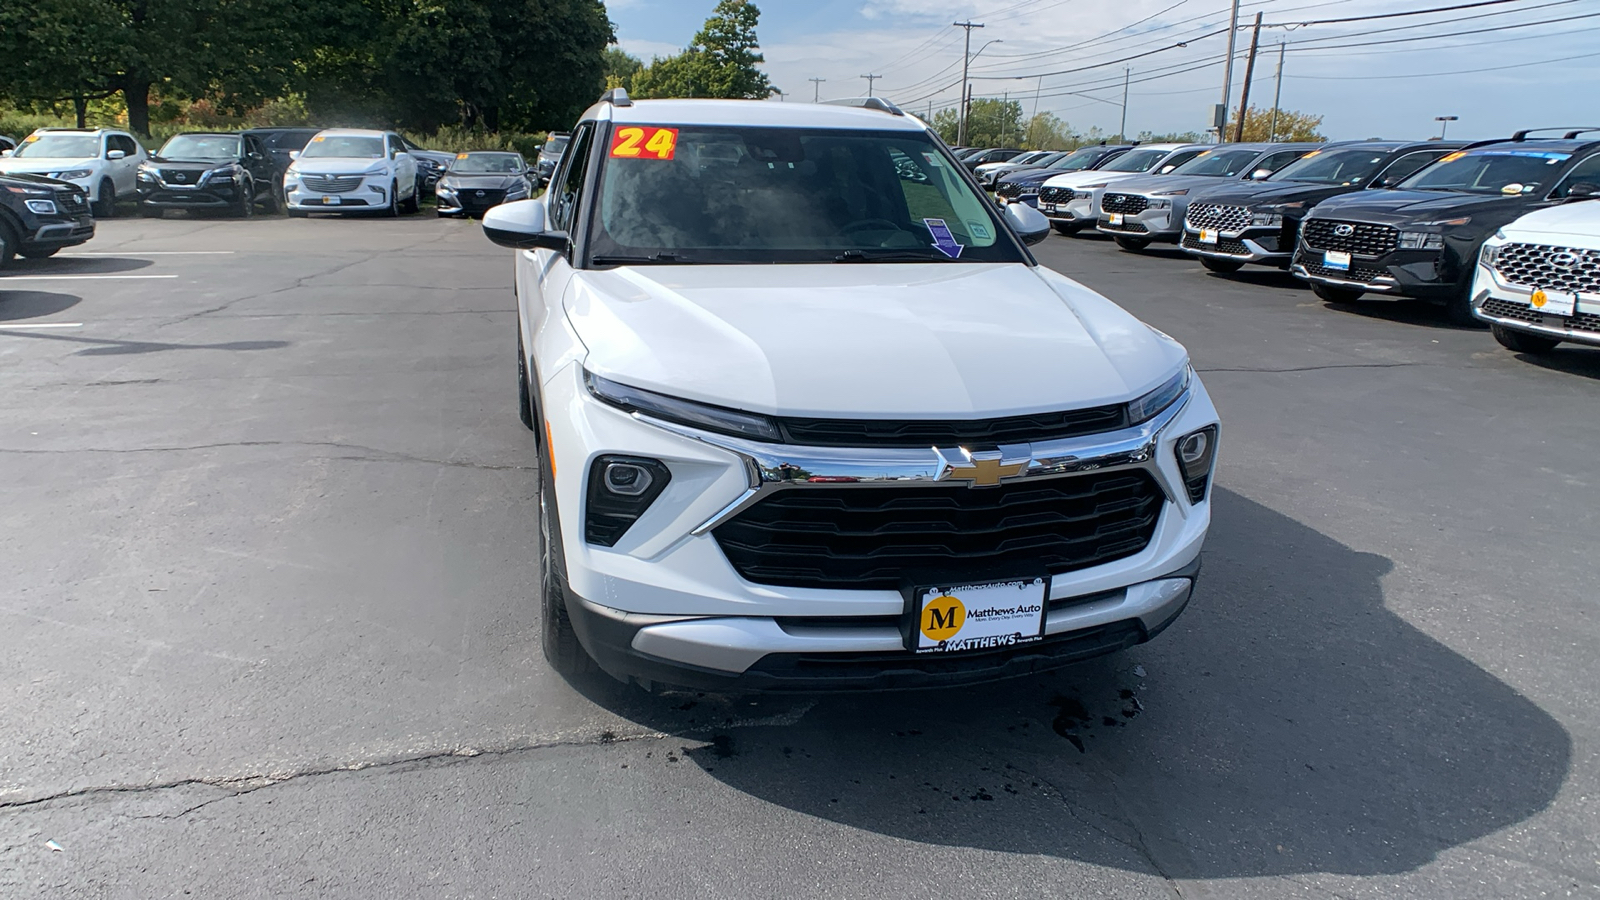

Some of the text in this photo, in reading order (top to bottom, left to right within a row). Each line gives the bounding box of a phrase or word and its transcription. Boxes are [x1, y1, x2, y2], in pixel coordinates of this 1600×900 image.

[612, 127, 675, 158] 24
[1534, 295, 1545, 304] M
[950, 581, 1025, 592] MatthewsAuto.com
[926, 606, 958, 630] M
[967, 604, 1041, 618] Matthews Auto
[945, 634, 1016, 652] MATTHEWS
